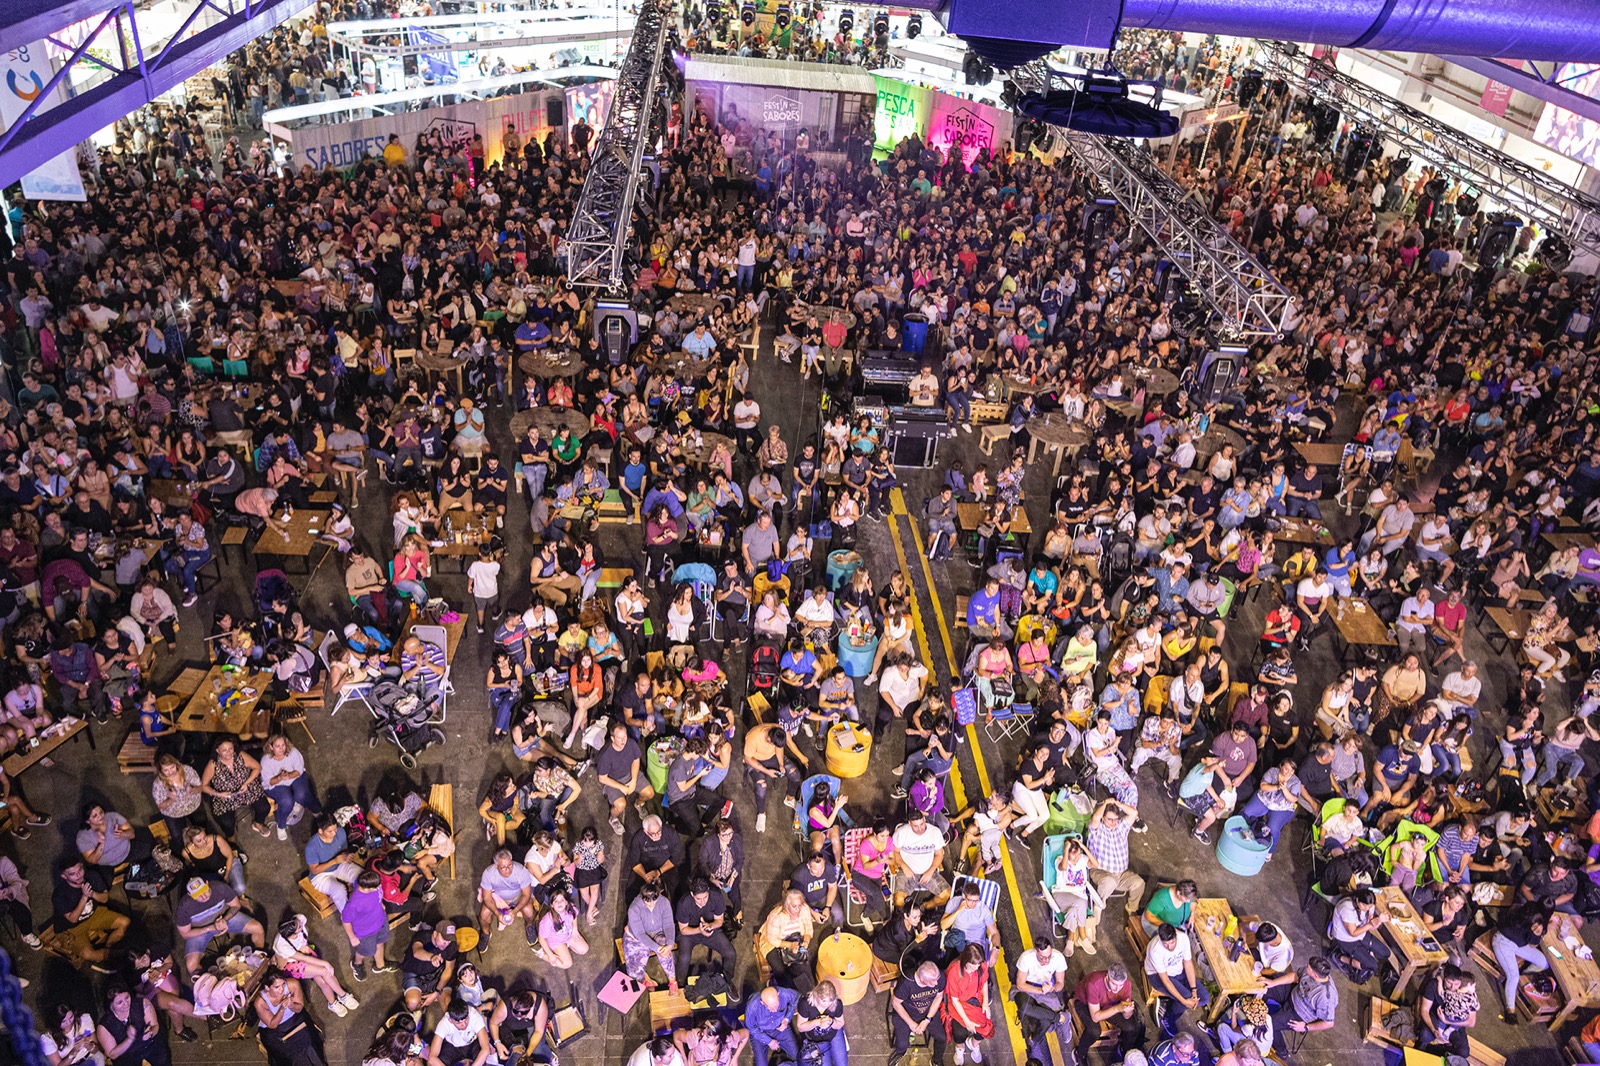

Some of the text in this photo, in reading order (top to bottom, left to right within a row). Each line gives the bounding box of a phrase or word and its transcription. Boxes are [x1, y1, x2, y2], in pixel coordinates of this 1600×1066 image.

[877, 90, 915, 118] PESCA
[763, 110, 800, 122] SABORES
[944, 128, 989, 149] SABORES
[305, 135, 386, 172] SABORES
[807, 879, 826, 893] CAT
